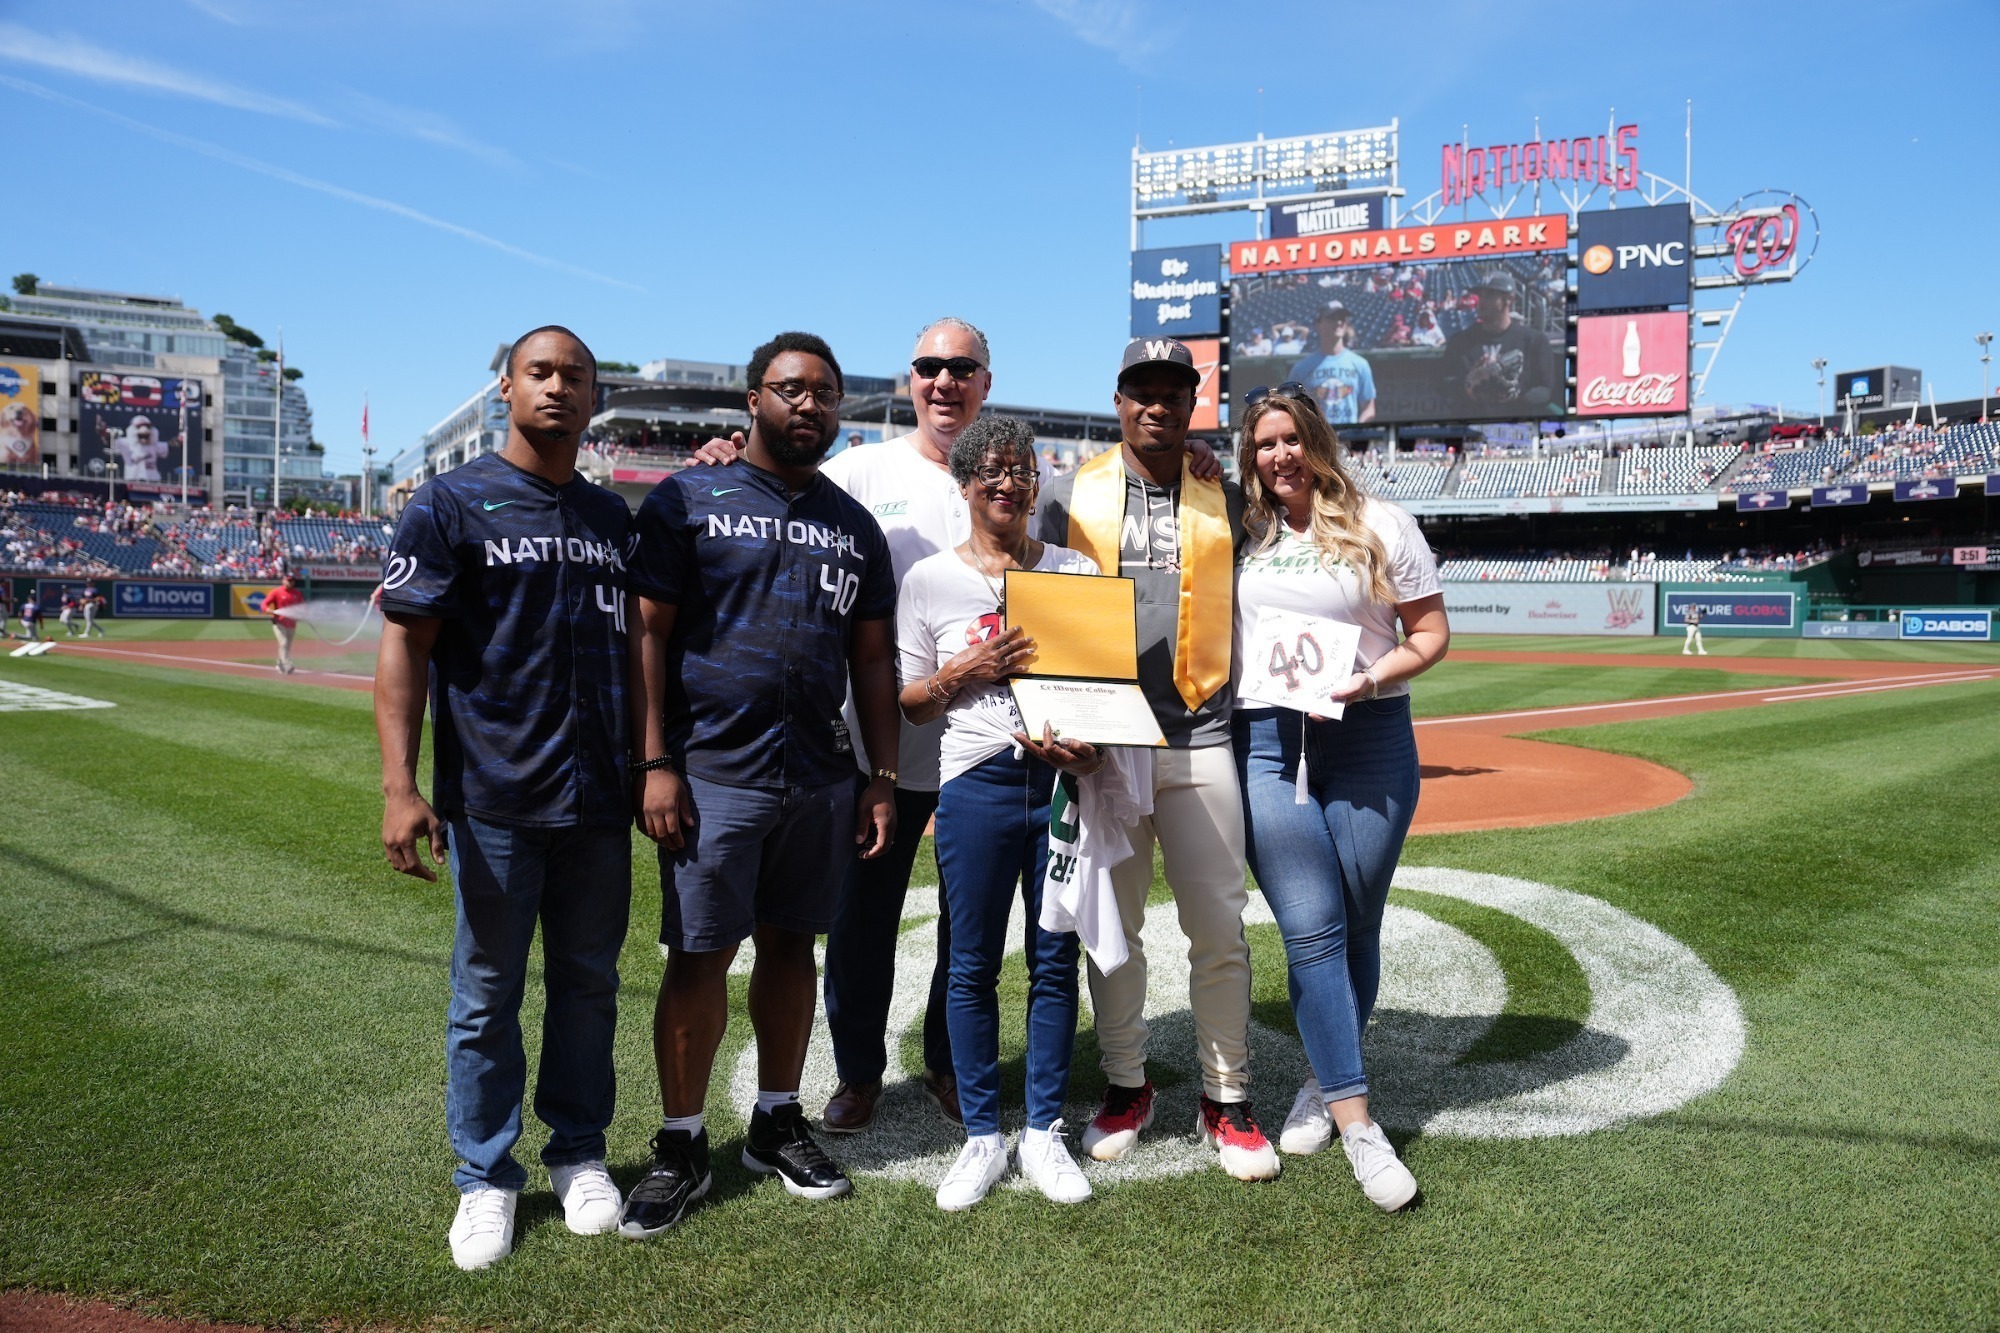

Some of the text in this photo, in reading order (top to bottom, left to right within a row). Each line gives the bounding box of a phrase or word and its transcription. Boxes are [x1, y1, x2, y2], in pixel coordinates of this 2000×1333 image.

[1442, 124, 1638, 205] NATIONALS
[1297, 203, 1369, 233] NATITUDE
[1241, 223, 1547, 267] NATIONALS PARK
[1616, 241, 1685, 270] PNC
[1161, 258, 1189, 277] The
[1133, 279, 1218, 300] Washington
[1157, 302, 1192, 325] Post
[1145, 340, 1173, 360] W
[1582, 373, 1681, 407] Coca-Cola
[84, 403, 198, 417] STEAMFITTES
[705, 514, 863, 560] NATIONL
[485, 537, 626, 573] NATIONL
[1960, 550, 1979, 561] 3:51
[148, 587, 205, 604] Inova
[819, 563, 860, 616] 40
[1444, 604, 1511, 615] resented by
[1672, 604, 1786, 616] VETURE GLOBAL
[1924, 620, 1987, 632] DABOS
[1269, 632, 1324, 692] 40
